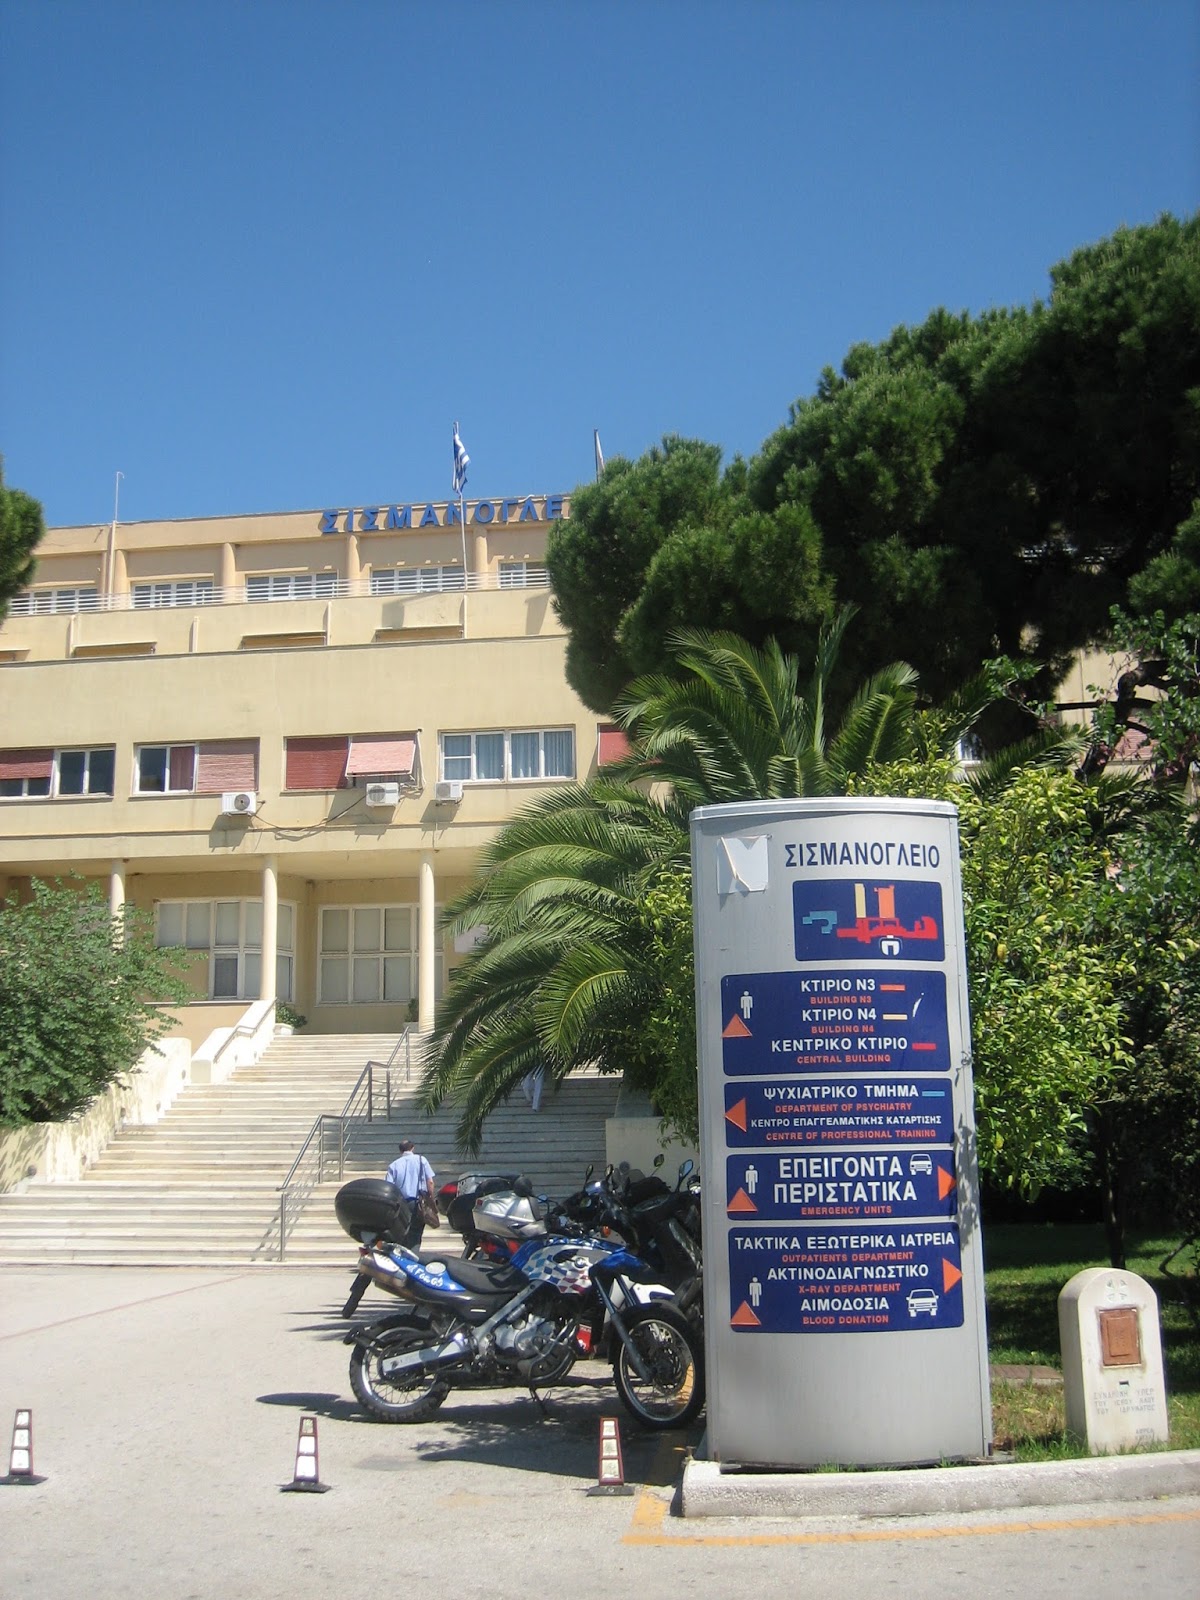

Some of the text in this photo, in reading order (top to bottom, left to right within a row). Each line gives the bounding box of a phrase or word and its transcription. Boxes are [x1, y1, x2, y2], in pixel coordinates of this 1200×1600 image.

[785, 842, 940, 868] ΣΙΣΜΑΝΟΓΛΕΙΟ
[801, 979, 851, 992] ΚΤΙΡΙΟ
[810, 996, 857, 1004] BUILDING
[802, 1009, 853, 1021] ΚΤΙΡΙΟ
[811, 1026, 859, 1034] BUILDING
[772, 1037, 907, 1052] ΚΕΝΤΡΙΚΟ ΚΤΙΡΙΟ
[797, 1055, 842, 1063] CENTRAL
[764, 1085, 919, 1100] ΨΥΧΙΑΤΡΙΚΟ ΤΜΗΜΑ
[775, 1104, 838, 1113] DEPARTMENT
[856, 1103, 912, 1111] PSYCHIATRY
[751, 1116, 941, 1128] ΚΕΝΤΡΟ ΕΠΑΓΓΕΛΜΑΤΙΚΗΣ ΚΑΤΑΡΤΙΣΗΣ
[766, 1132, 803, 1141] CENTRE
[821, 1130, 892, 1139] PROFESSIONAL
[779, 1156, 903, 1178] ΕΠΕΙΓΟΝΤΑ
[774, 1181, 917, 1204] ΠΕΡΙΣΤΑΤΙΚΑ
[802, 1206, 892, 1215] EMERGENCY UNITS
[735, 1232, 955, 1250] ΤΑΚΤΙΚΑ ΕΞΩΤΕΡΙΚΑ ΙΑΤΡΕΙΑ
[782, 1252, 913, 1262] OUTPATIENTS DEPARTMENT
[767, 1264, 929, 1280] ΑΚΤΙΝΟΔΙΑΓΝΩΣΤΙΚΟ
[799, 1283, 901, 1294] X-RAY DEPARTMENT
[801, 1297, 889, 1311] ΑΙΜΟΔΟΣΙΑ
[803, 1315, 889, 1325] BLOOD DONATION
